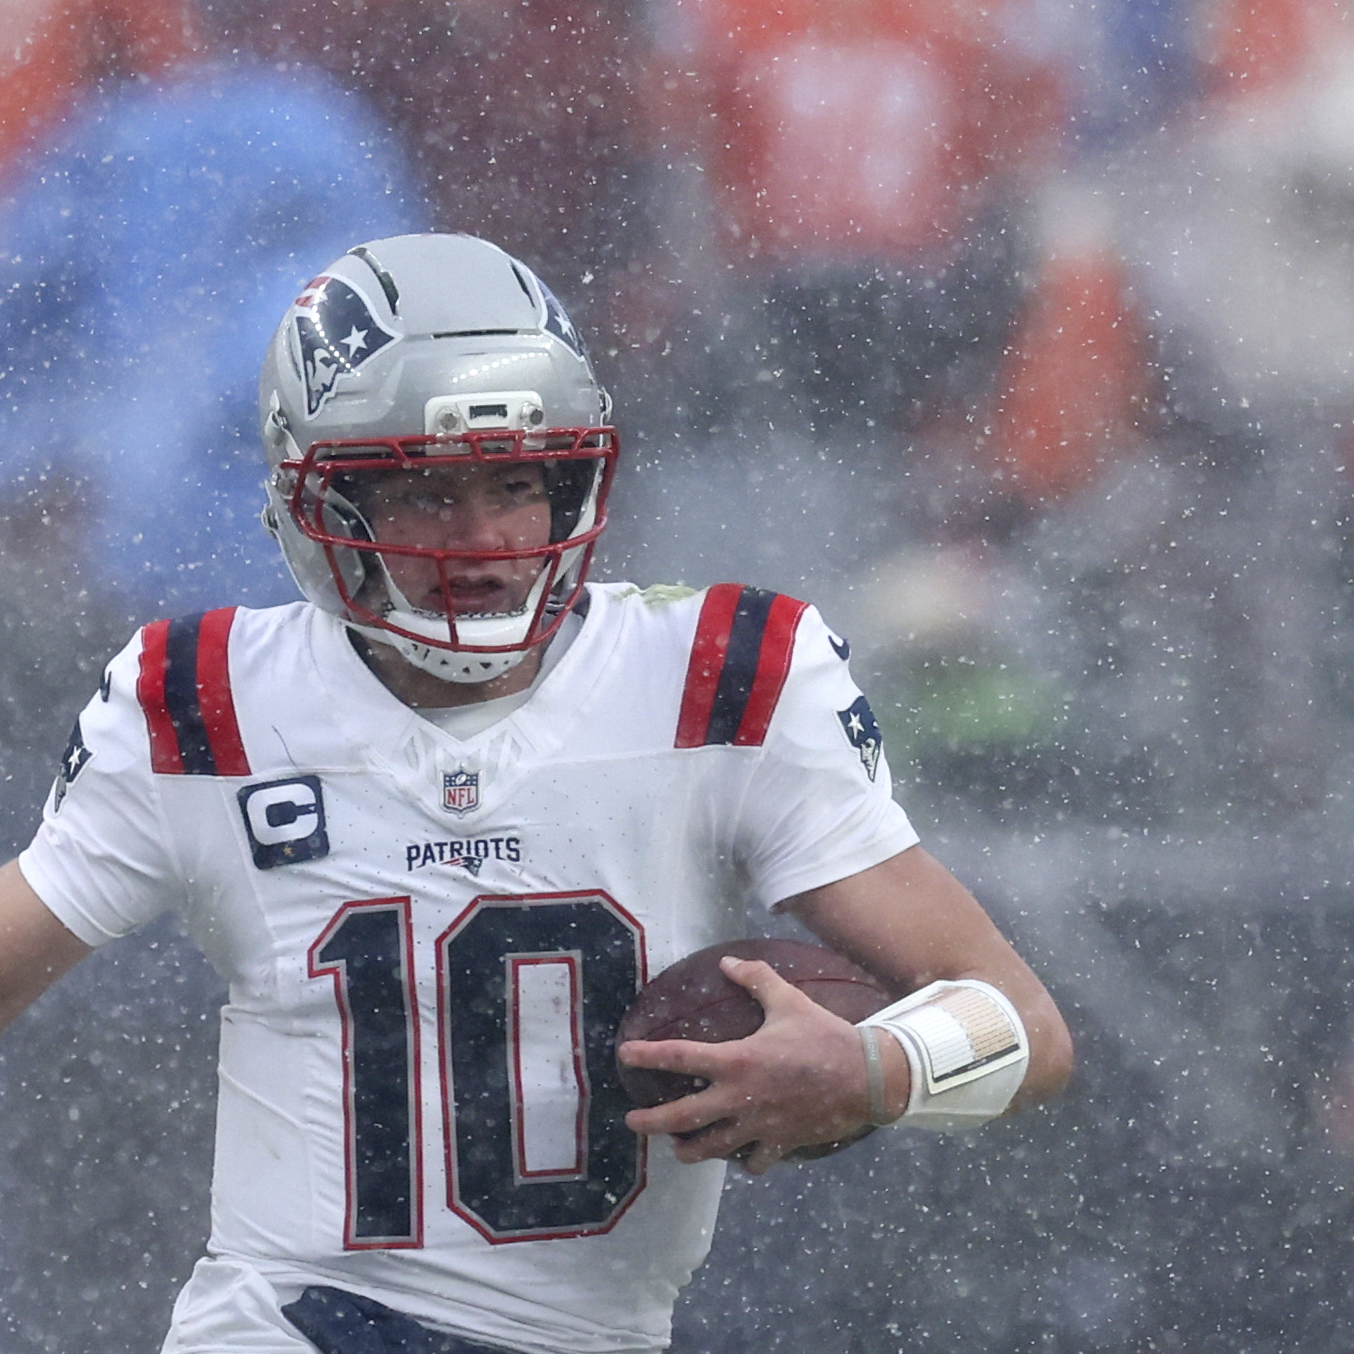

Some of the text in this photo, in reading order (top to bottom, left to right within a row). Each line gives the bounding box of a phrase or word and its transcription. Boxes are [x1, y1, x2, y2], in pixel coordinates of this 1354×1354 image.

[446, 787, 475, 807] NFL
[406, 837, 521, 872] PATRIOTS
[307, 888, 647, 1251] 10
